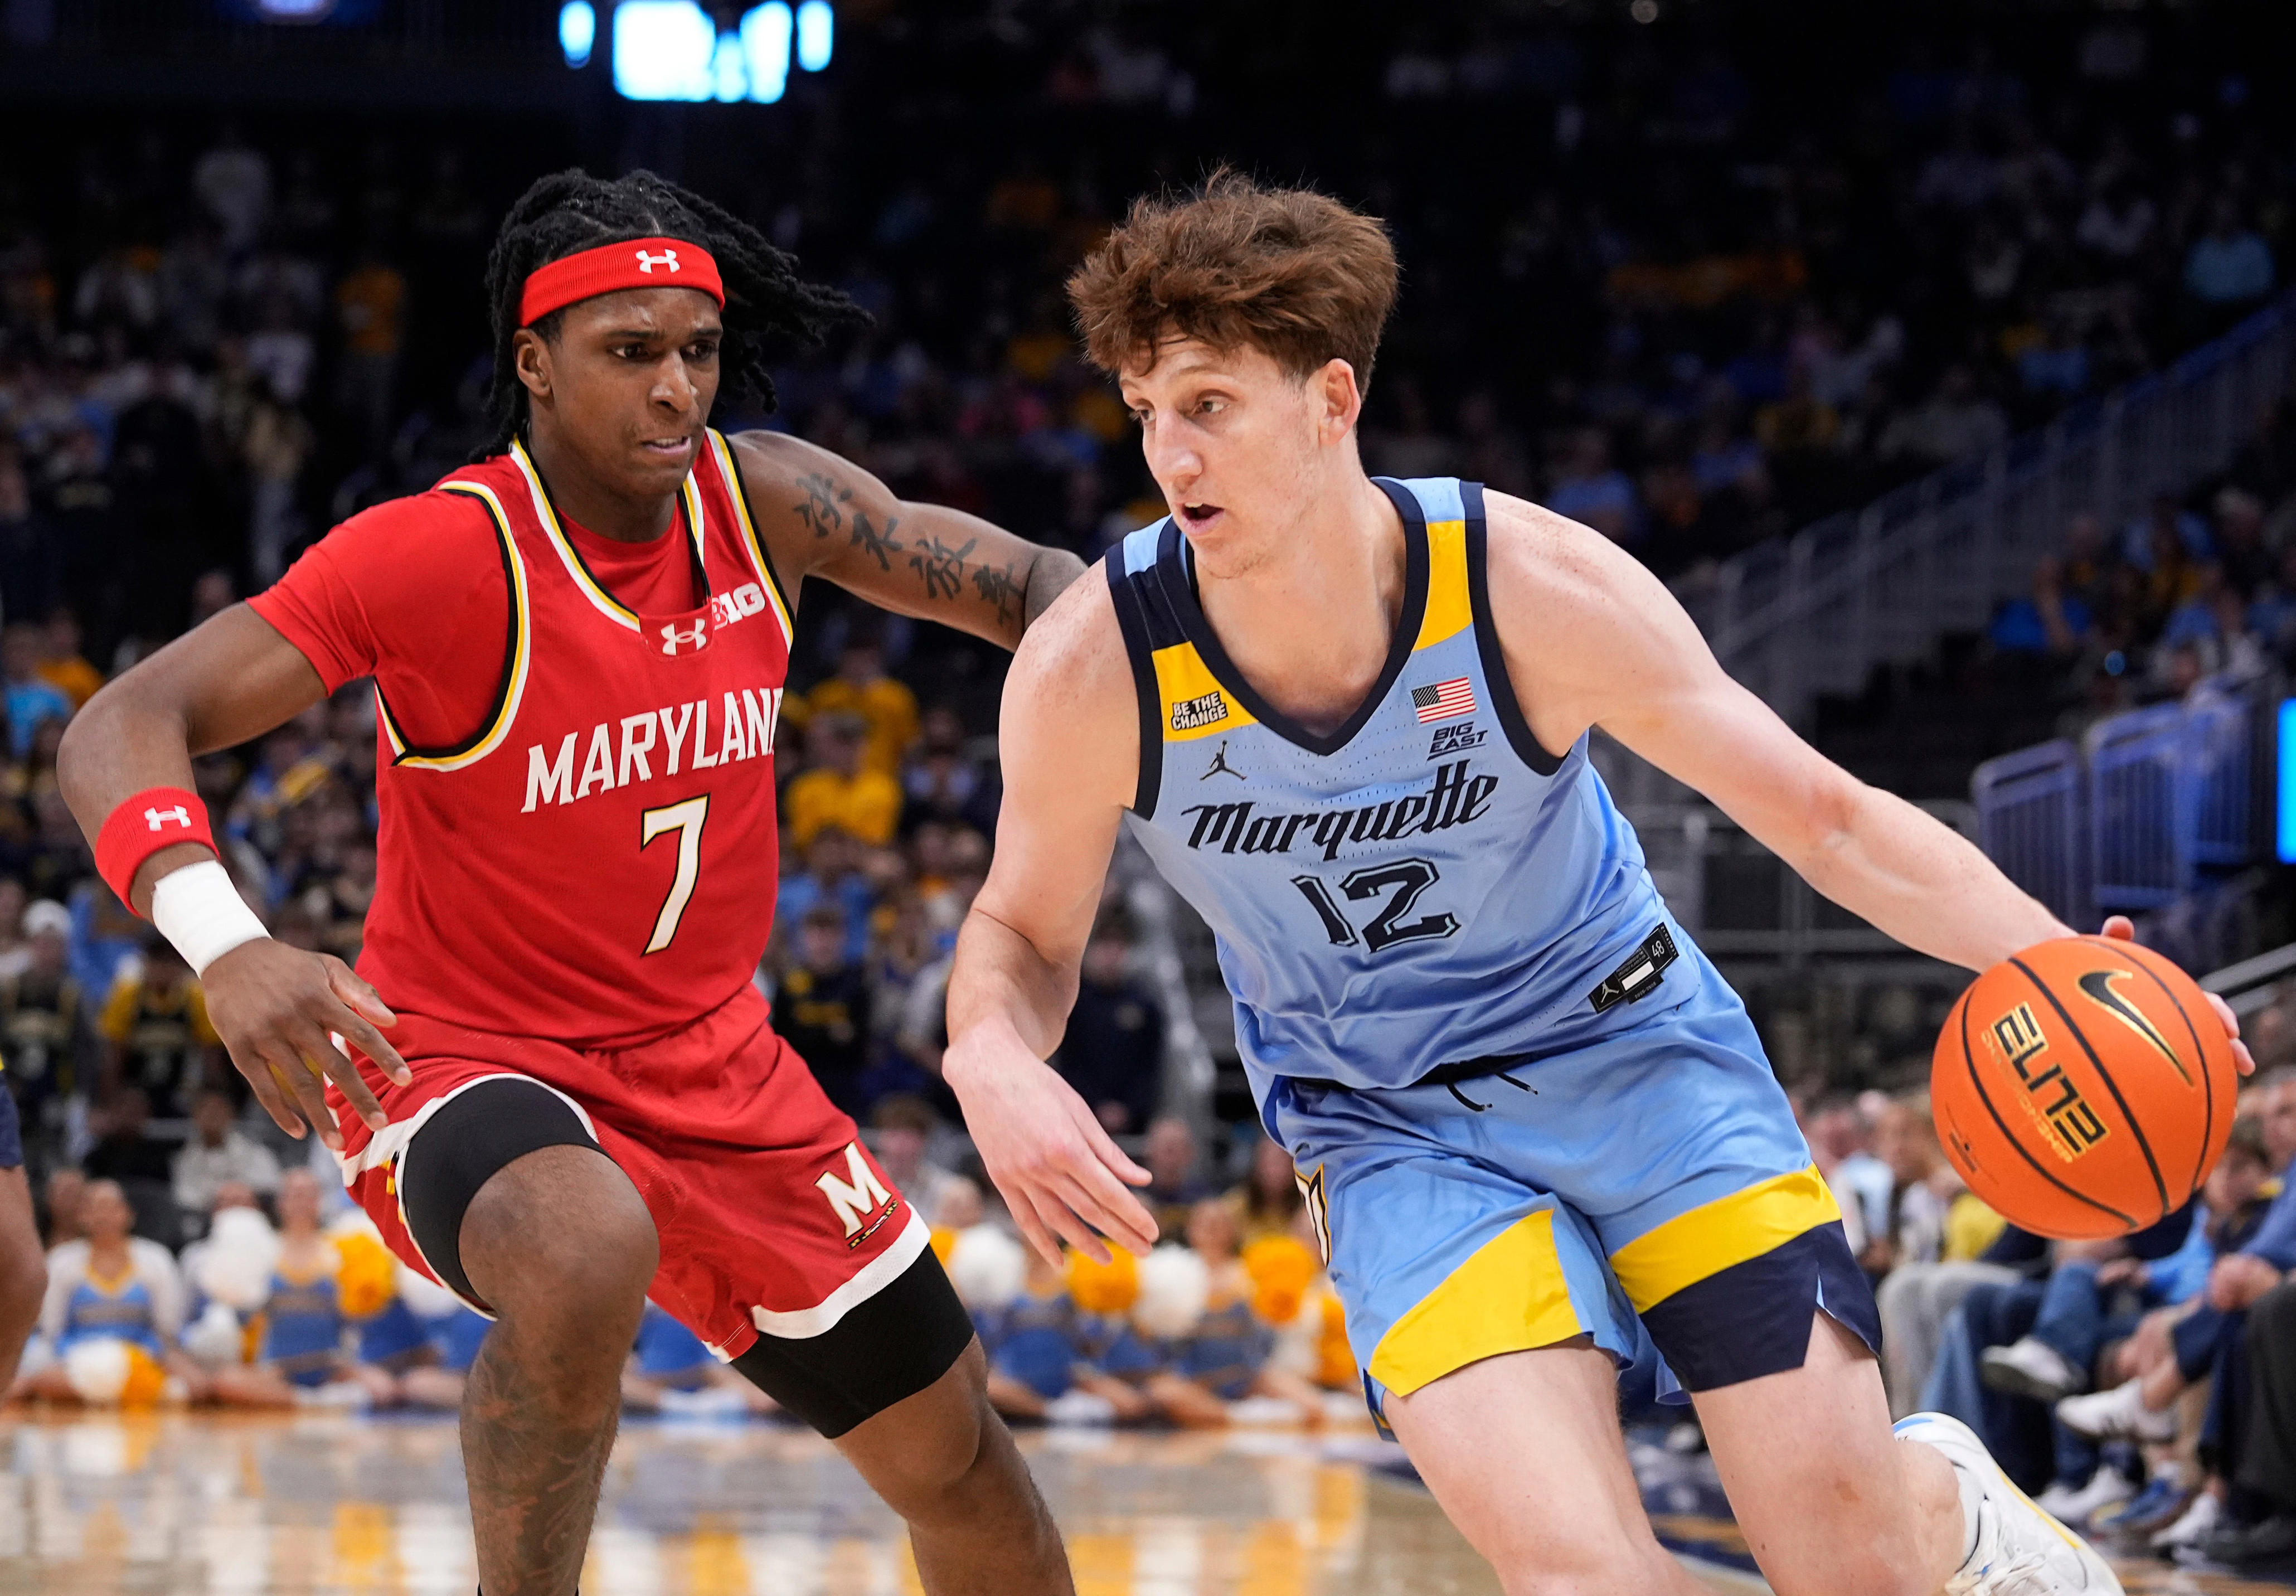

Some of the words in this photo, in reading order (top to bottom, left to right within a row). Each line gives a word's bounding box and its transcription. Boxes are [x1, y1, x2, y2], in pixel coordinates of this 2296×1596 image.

[1172, 704, 1227, 730] CHANGE
[1173, 702, 1191, 717] BE
[1192, 692, 1220, 713] THE
[1429, 730, 1488, 754] EAST
[1433, 720, 1474, 741] BIG
[1181, 759, 1499, 861] Marquette
[640, 793, 711, 957] 7
[1290, 857, 1462, 954] 12
[1652, 940, 1664, 958] 48
[1981, 1029, 2073, 1163] CHONSHIP
[1990, 1001, 2111, 1155] ELITE
[814, 1139, 892, 1241] M
